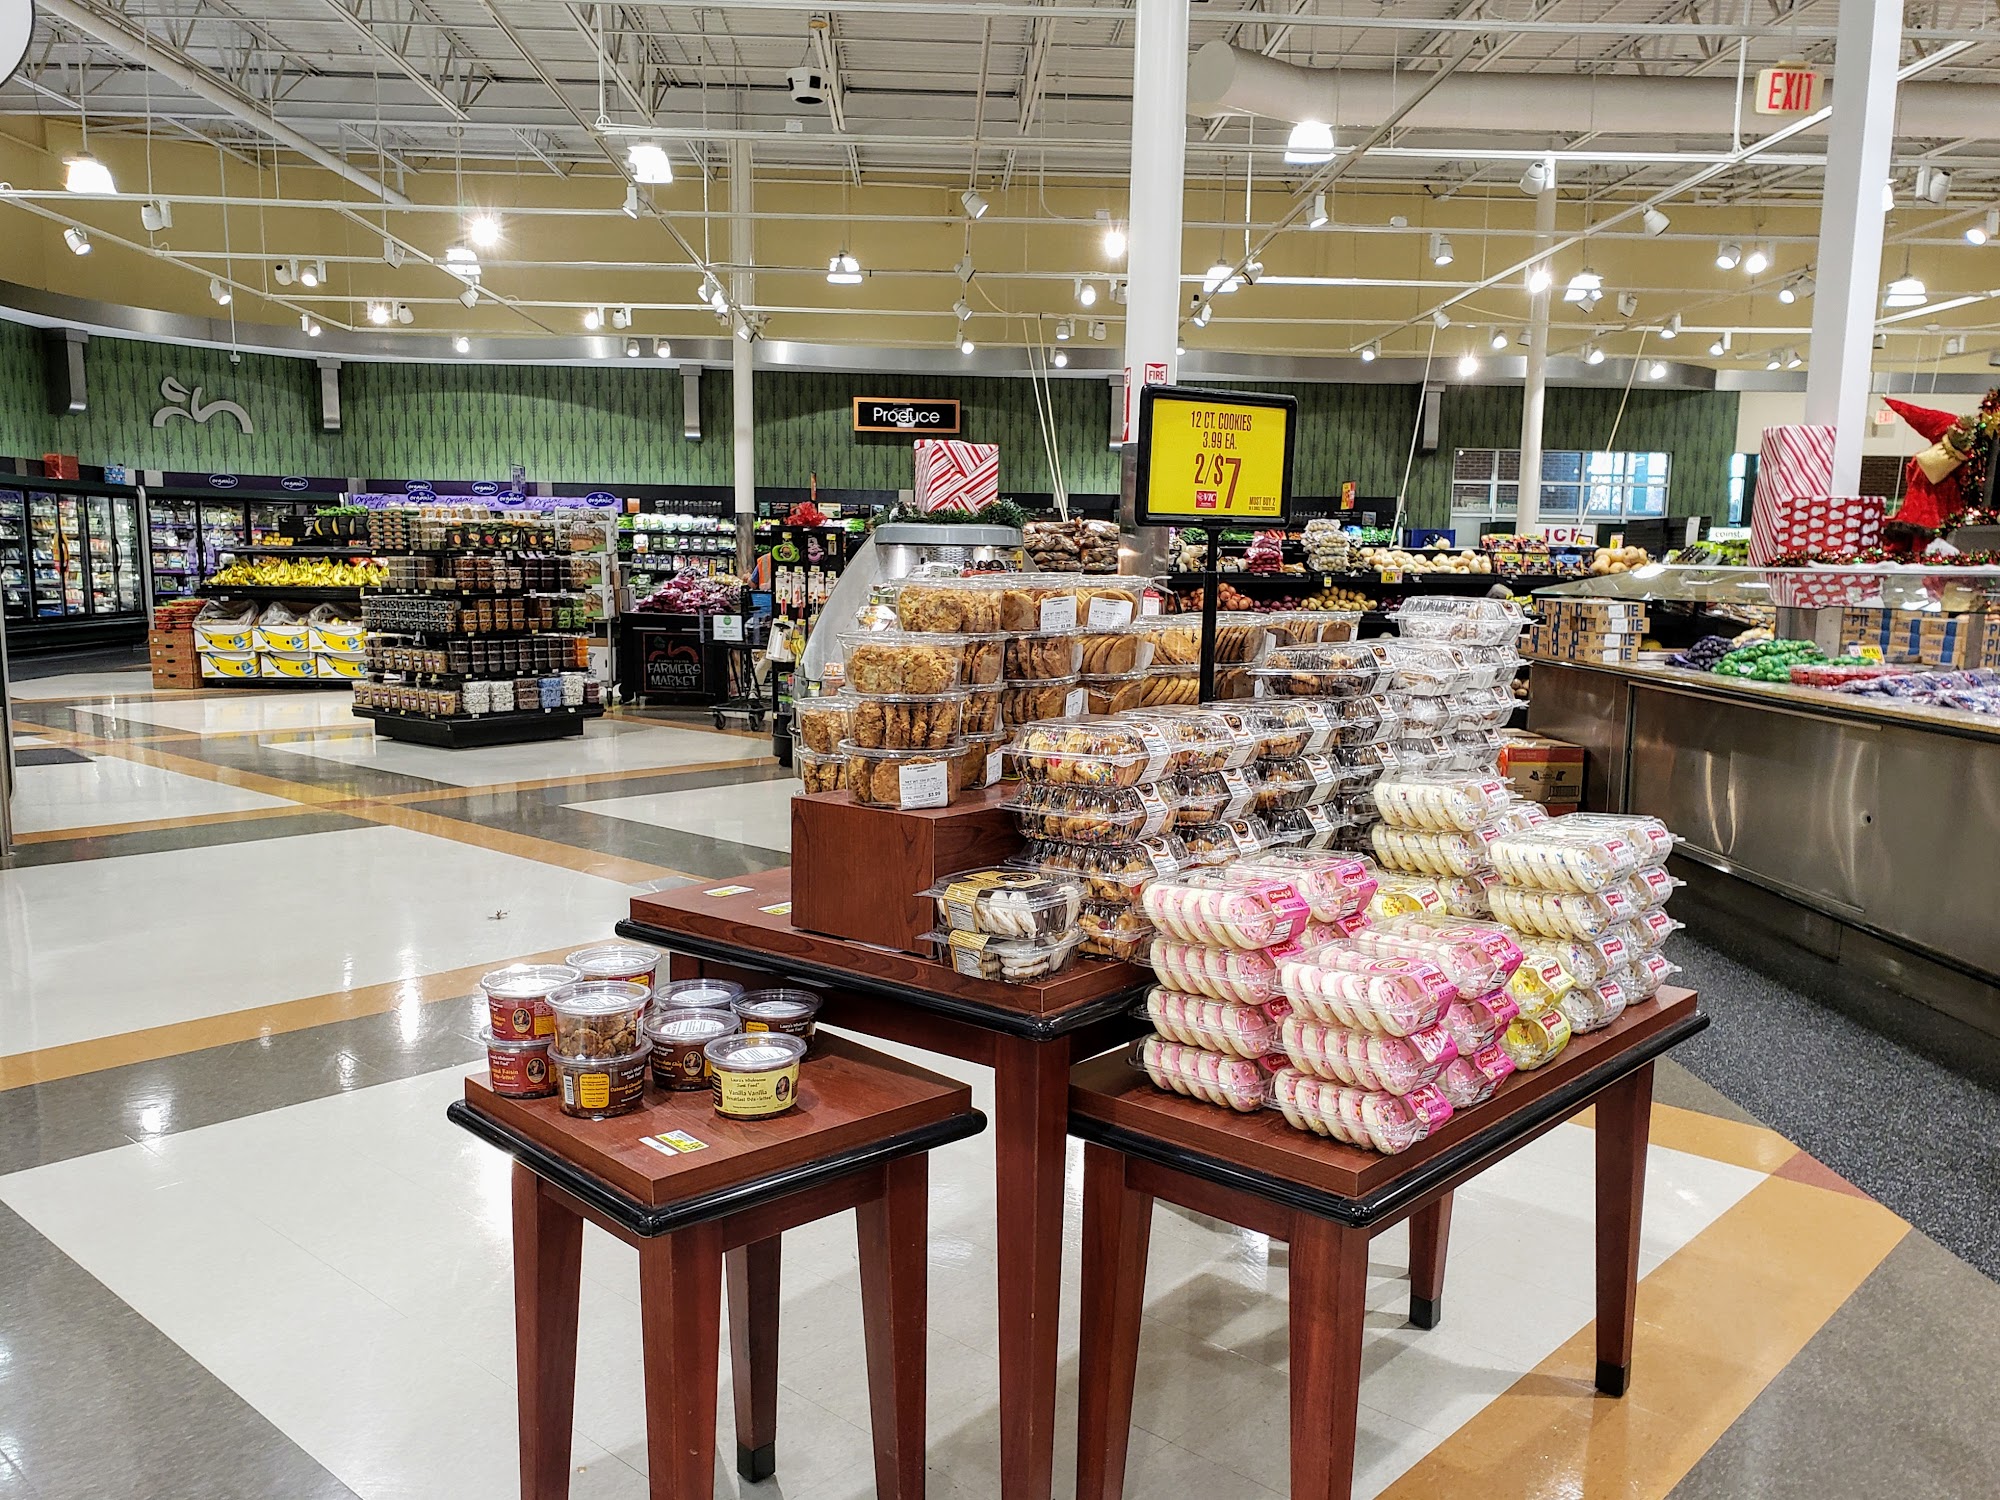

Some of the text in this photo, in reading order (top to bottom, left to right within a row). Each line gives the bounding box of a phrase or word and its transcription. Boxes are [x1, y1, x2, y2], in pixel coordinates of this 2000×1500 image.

[1768, 72, 1816, 110] EXIT
[1148, 370, 1164, 380] FIRE
[873, 407, 940, 423] Produce
[1191, 410, 1252, 431] 12 CT. COOKIES
[1202, 431, 1238, 450] 3.99 EA.
[474, 484, 496, 492] organic
[409, 494, 434, 502] organic
[498, 495, 524, 504] organic
[588, 496, 613, 505] organic
[1203, 492, 1216, 502] VIC
[1250, 496, 1276, 506] MUST BUY 2
[647, 662, 701, 675] FARMERS
[651, 675, 698, 686] MARKET
